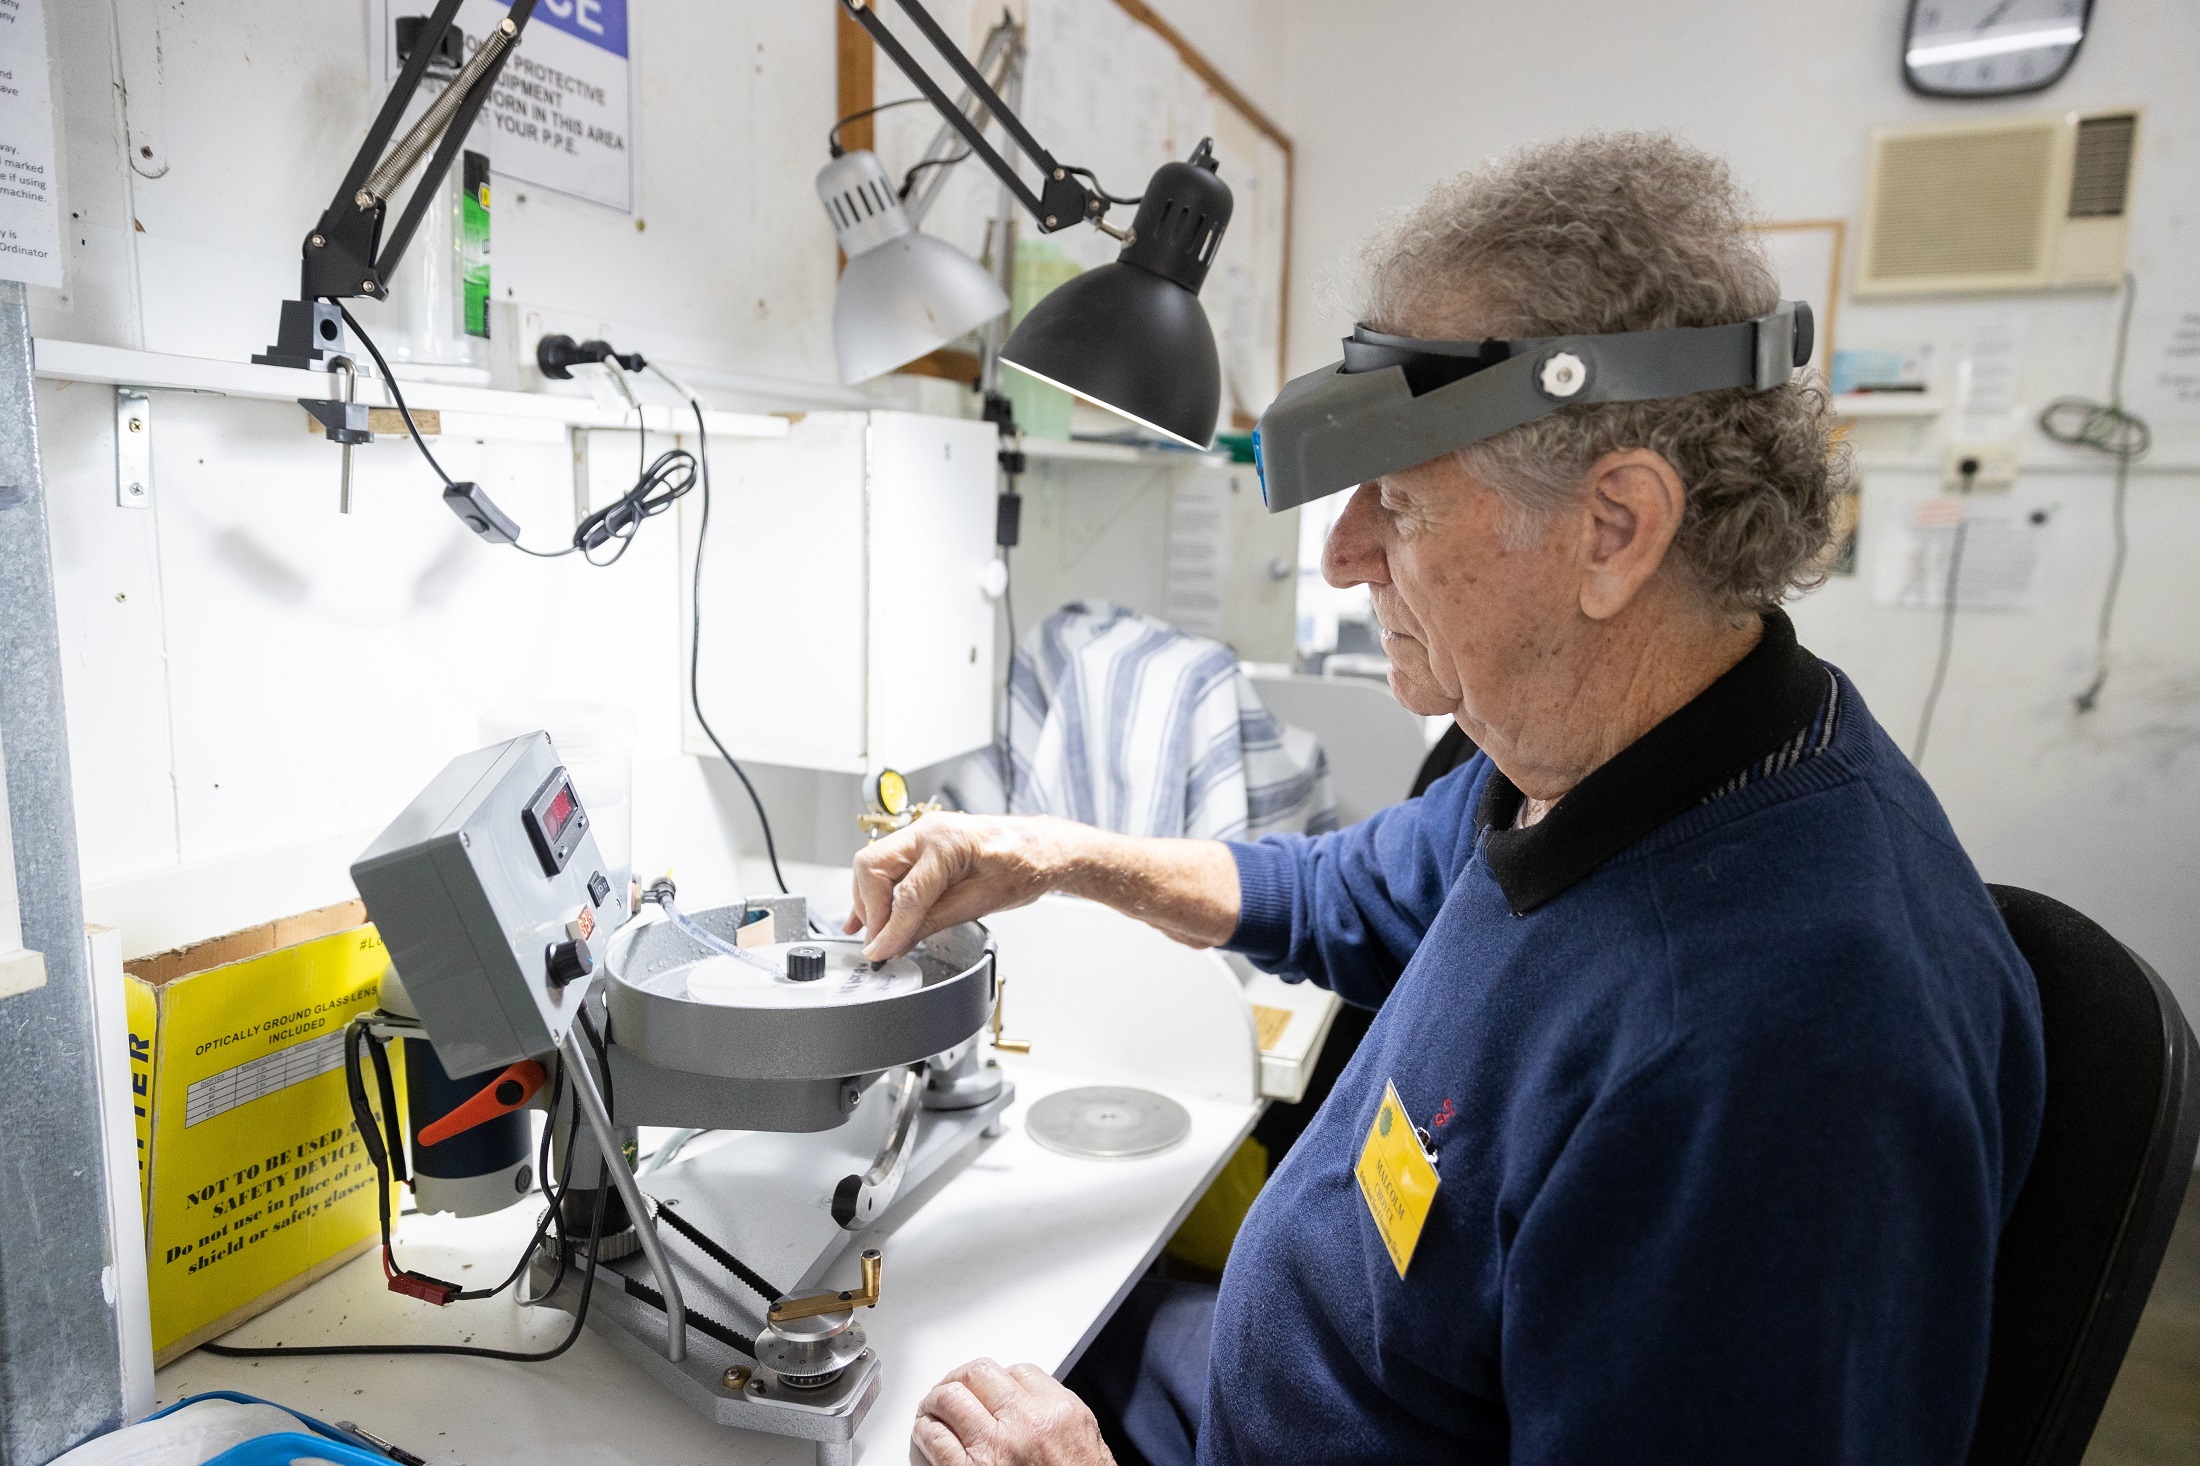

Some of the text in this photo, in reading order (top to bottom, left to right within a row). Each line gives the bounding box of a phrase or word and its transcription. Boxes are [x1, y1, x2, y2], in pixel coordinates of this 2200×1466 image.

[497, 72, 562, 108] UIPMENT
[514, 54, 605, 106] PROTECTIVE
[494, 110, 538, 141] YOUR
[532, 104, 546, 122] IN
[552, 110, 582, 136] THIS
[587, 125, 625, 151] AREA
[4, 159, 44, 174] marked
[9, 173, 17, 182] if
[19, 177, 47, 191] using
[0, 187, 47, 203] machine.
[9, 230, 17, 239] is
[195, 1024, 260, 1056] OPTICALLY
[263, 1008, 312, 1031] GROUND
[314, 995, 349, 1014] GLASS
[268, 1018, 325, 1045] INCLUDED
[201, 1073, 225, 1088] DIOPTER
[186, 1177, 229, 1210] NOT
[233, 1164, 260, 1186] TO
[265, 1150, 291, 1172] BE
[297, 1128, 343, 1158] USED
[212, 1139, 359, 1219] SAFETY DEVICE
[1376, 1158, 1404, 1220] MALCOLM
[165, 1244, 193, 1265] Do
[198, 1223, 228, 1248] not
[233, 1209, 262, 1230] use
[267, 1199, 284, 1215] in
[289, 1176, 330, 1209] place
[334, 1165, 349, 1181] of
[187, 1175, 375, 1275] shield or safety glasses
